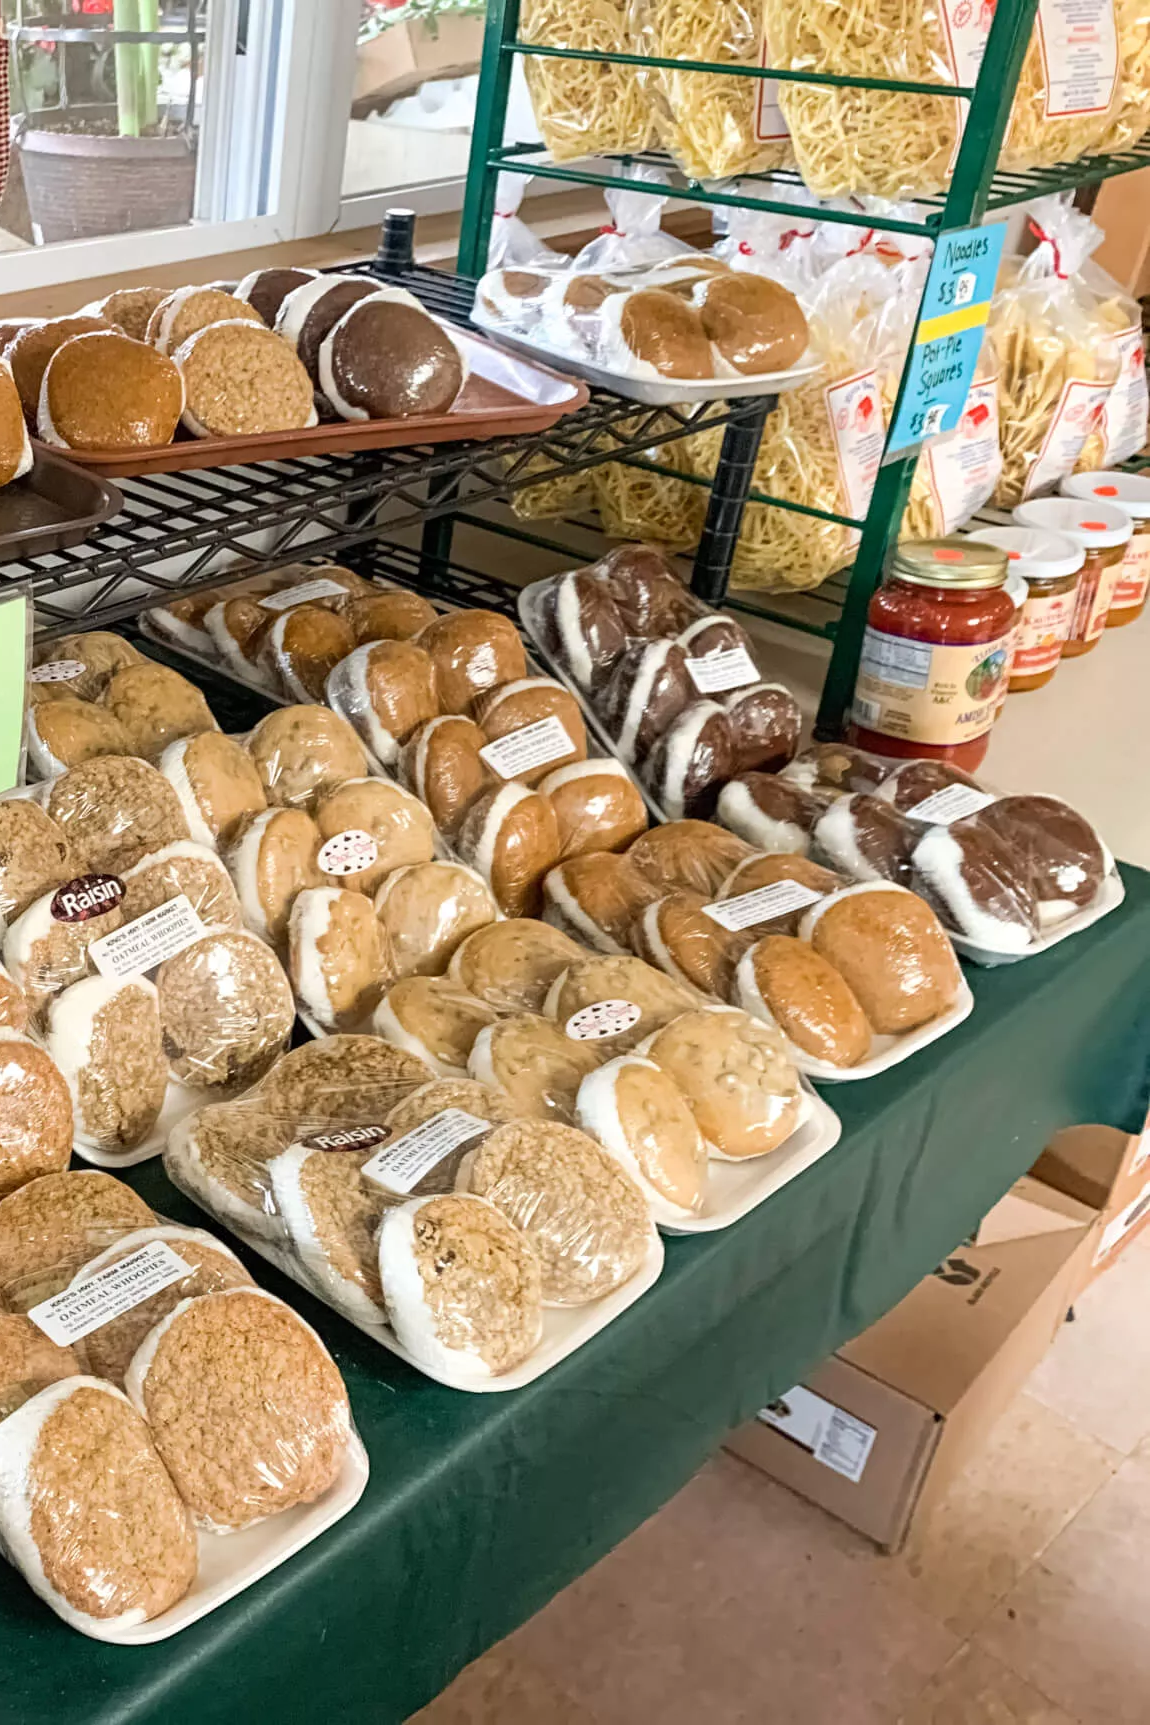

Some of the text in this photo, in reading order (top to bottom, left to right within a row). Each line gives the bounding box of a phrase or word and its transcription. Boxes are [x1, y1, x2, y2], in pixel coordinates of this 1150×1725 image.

[943, 237, 989, 269] Noodles
[917, 361, 962, 400] Squares
[61, 879, 122, 917] Raisin
[112, 939, 150, 963] OATMEAL
[313, 1125, 387, 1150] Raisin
[59, 1290, 111, 1321] OATMEAL
[111, 1259, 166, 1289] WHOOPIES
